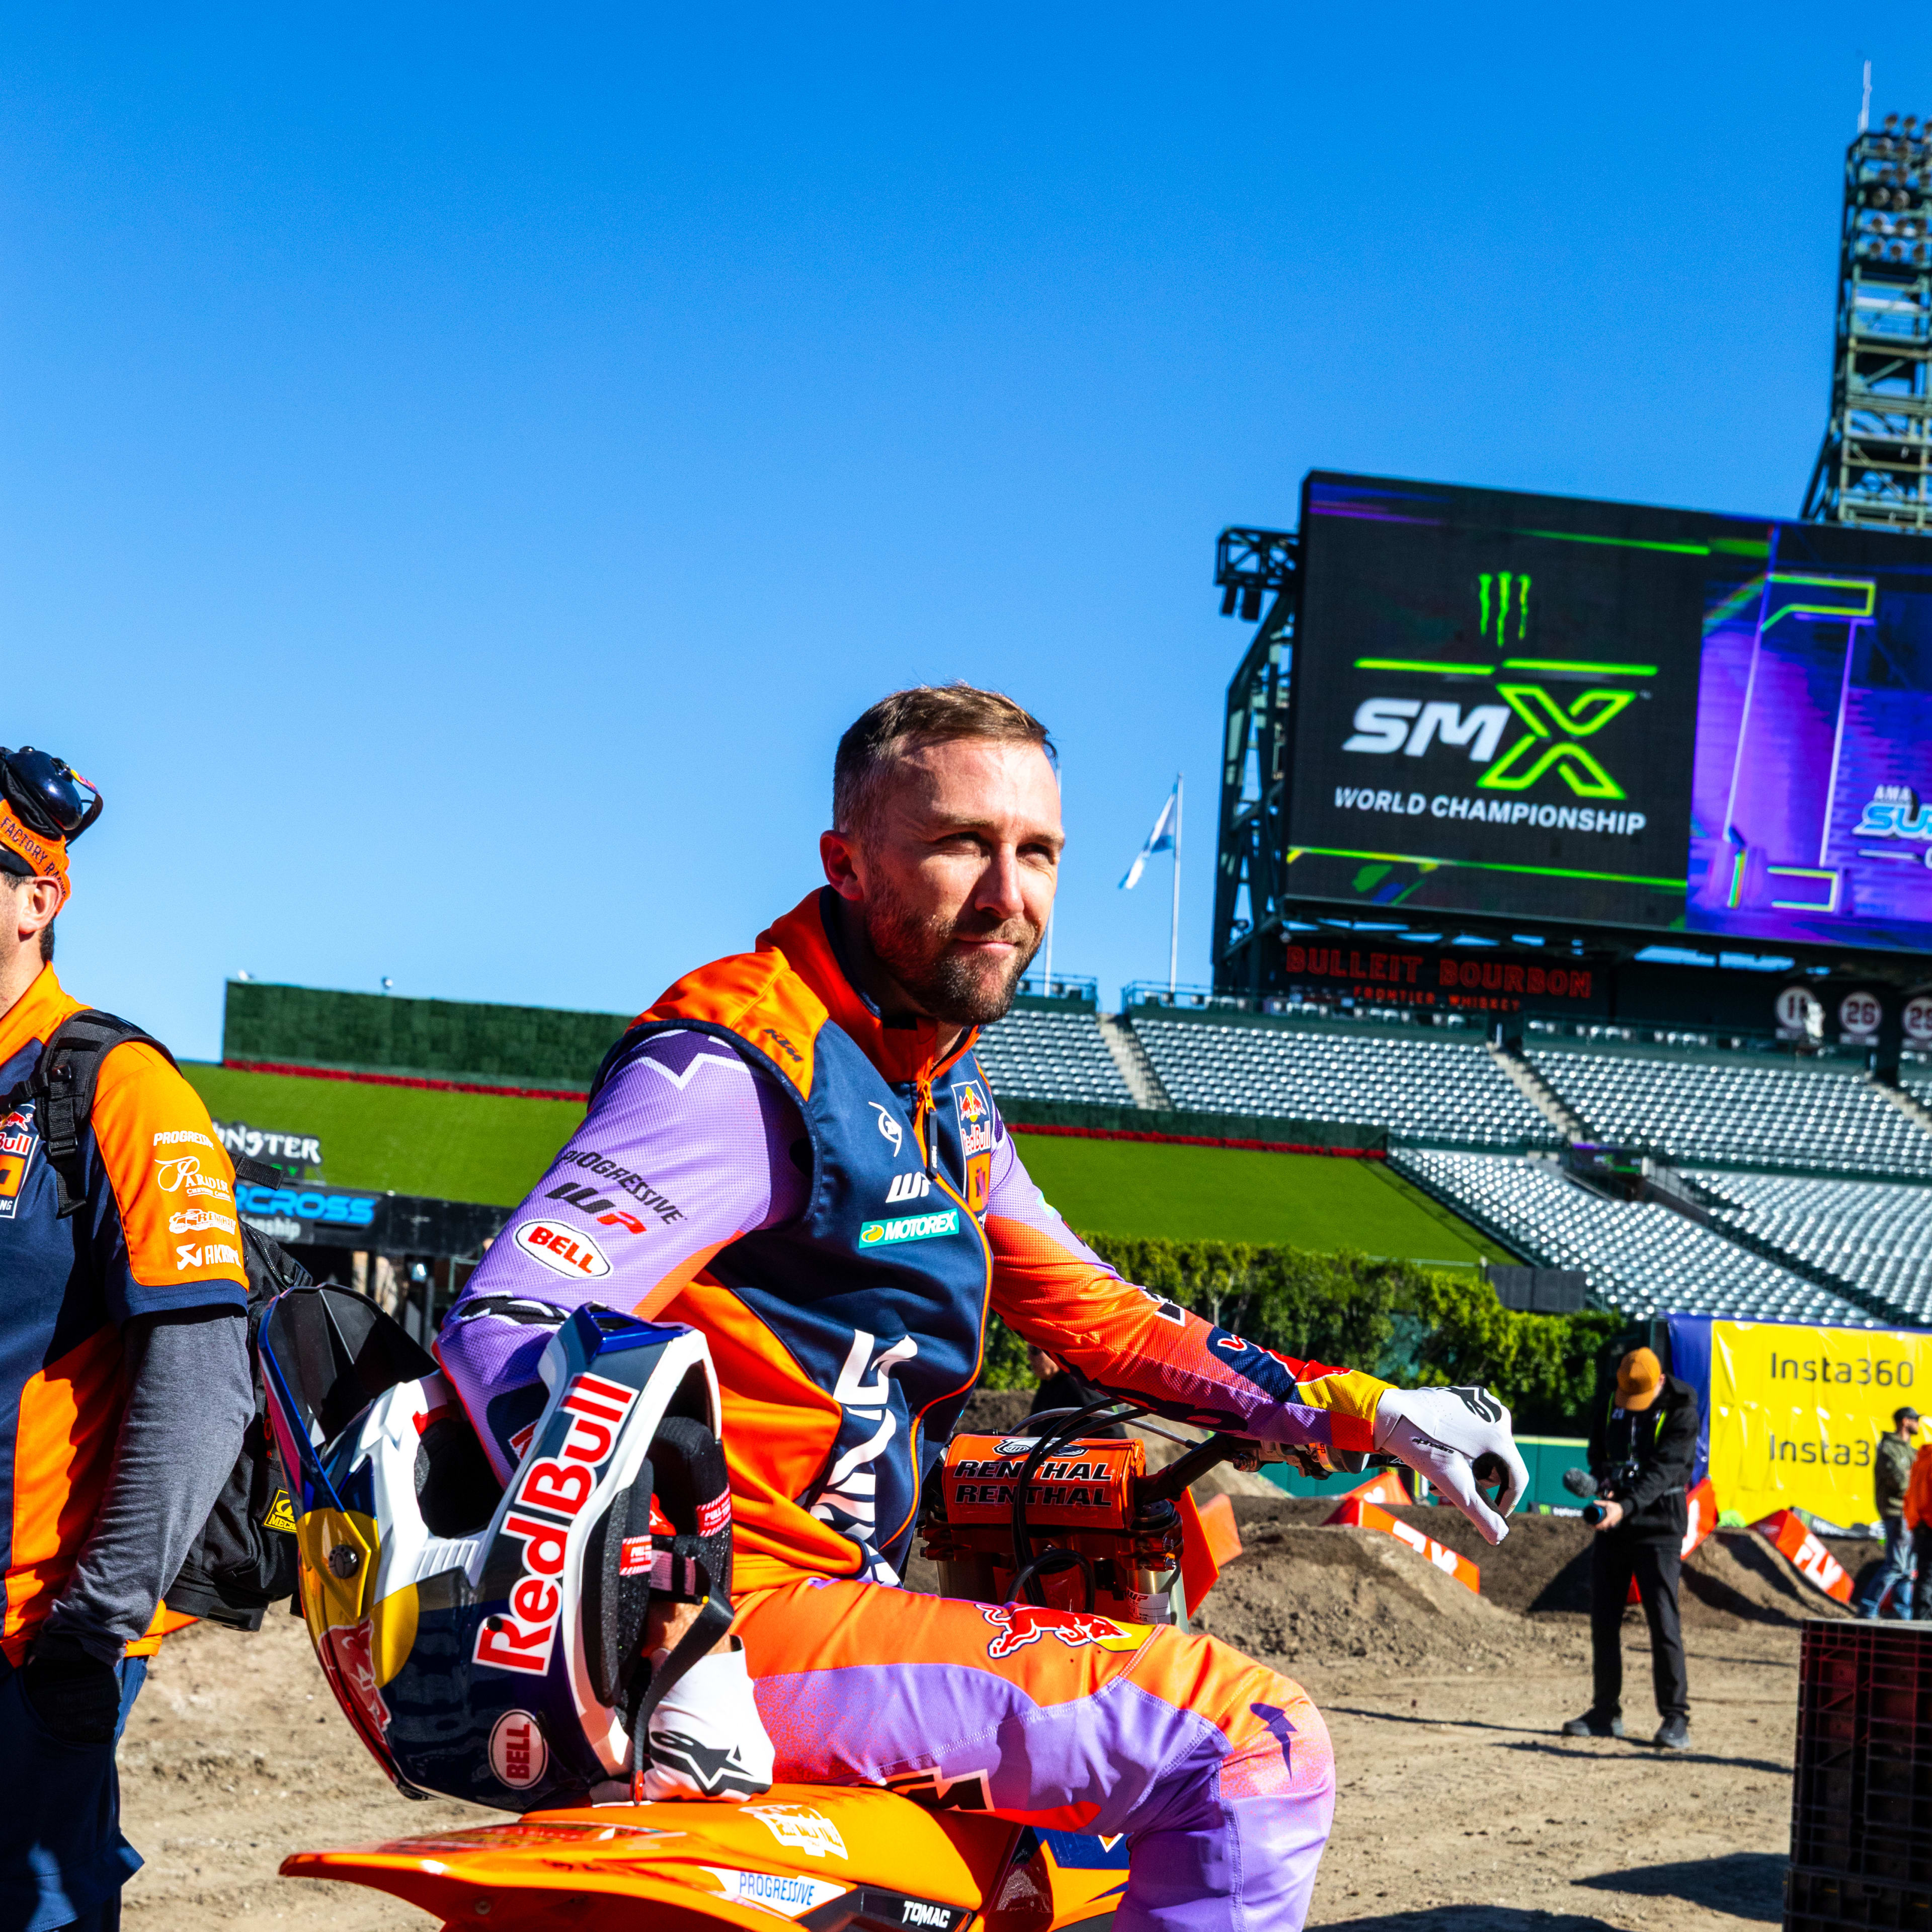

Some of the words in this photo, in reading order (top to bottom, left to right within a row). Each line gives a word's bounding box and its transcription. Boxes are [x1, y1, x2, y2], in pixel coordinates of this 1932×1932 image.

[1342, 683, 1636, 800] SMX
[1334, 785, 1427, 815] WORLD
[1430, 794, 1646, 836] CHAMPIONSHIP
[1874, 784, 1911, 800] AMA
[1, 817, 48, 864] FACTORY
[1286, 945, 1424, 983] BULLEIT
[1439, 958, 1591, 998] BOURBON
[1846, 1001, 1876, 1024] 26
[763, 1029, 803, 1062] KTM
[212, 1121, 321, 1164] NSTER
[236, 1184, 376, 1225] CROSS
[554, 1151, 684, 1225] PROGRESSIVE
[884, 1212, 956, 1240] MOTOREX
[528, 1226, 592, 1274] BELL
[1771, 1352, 1914, 1388] Insta360
[1769, 1434, 1870, 1466] Insta3
[268, 1514, 296, 1530] MECH
[506, 1724, 530, 1780] BELL
[740, 1872, 815, 1906] PROGRESSIVE
[902, 1901, 950, 1928] TOMAC
